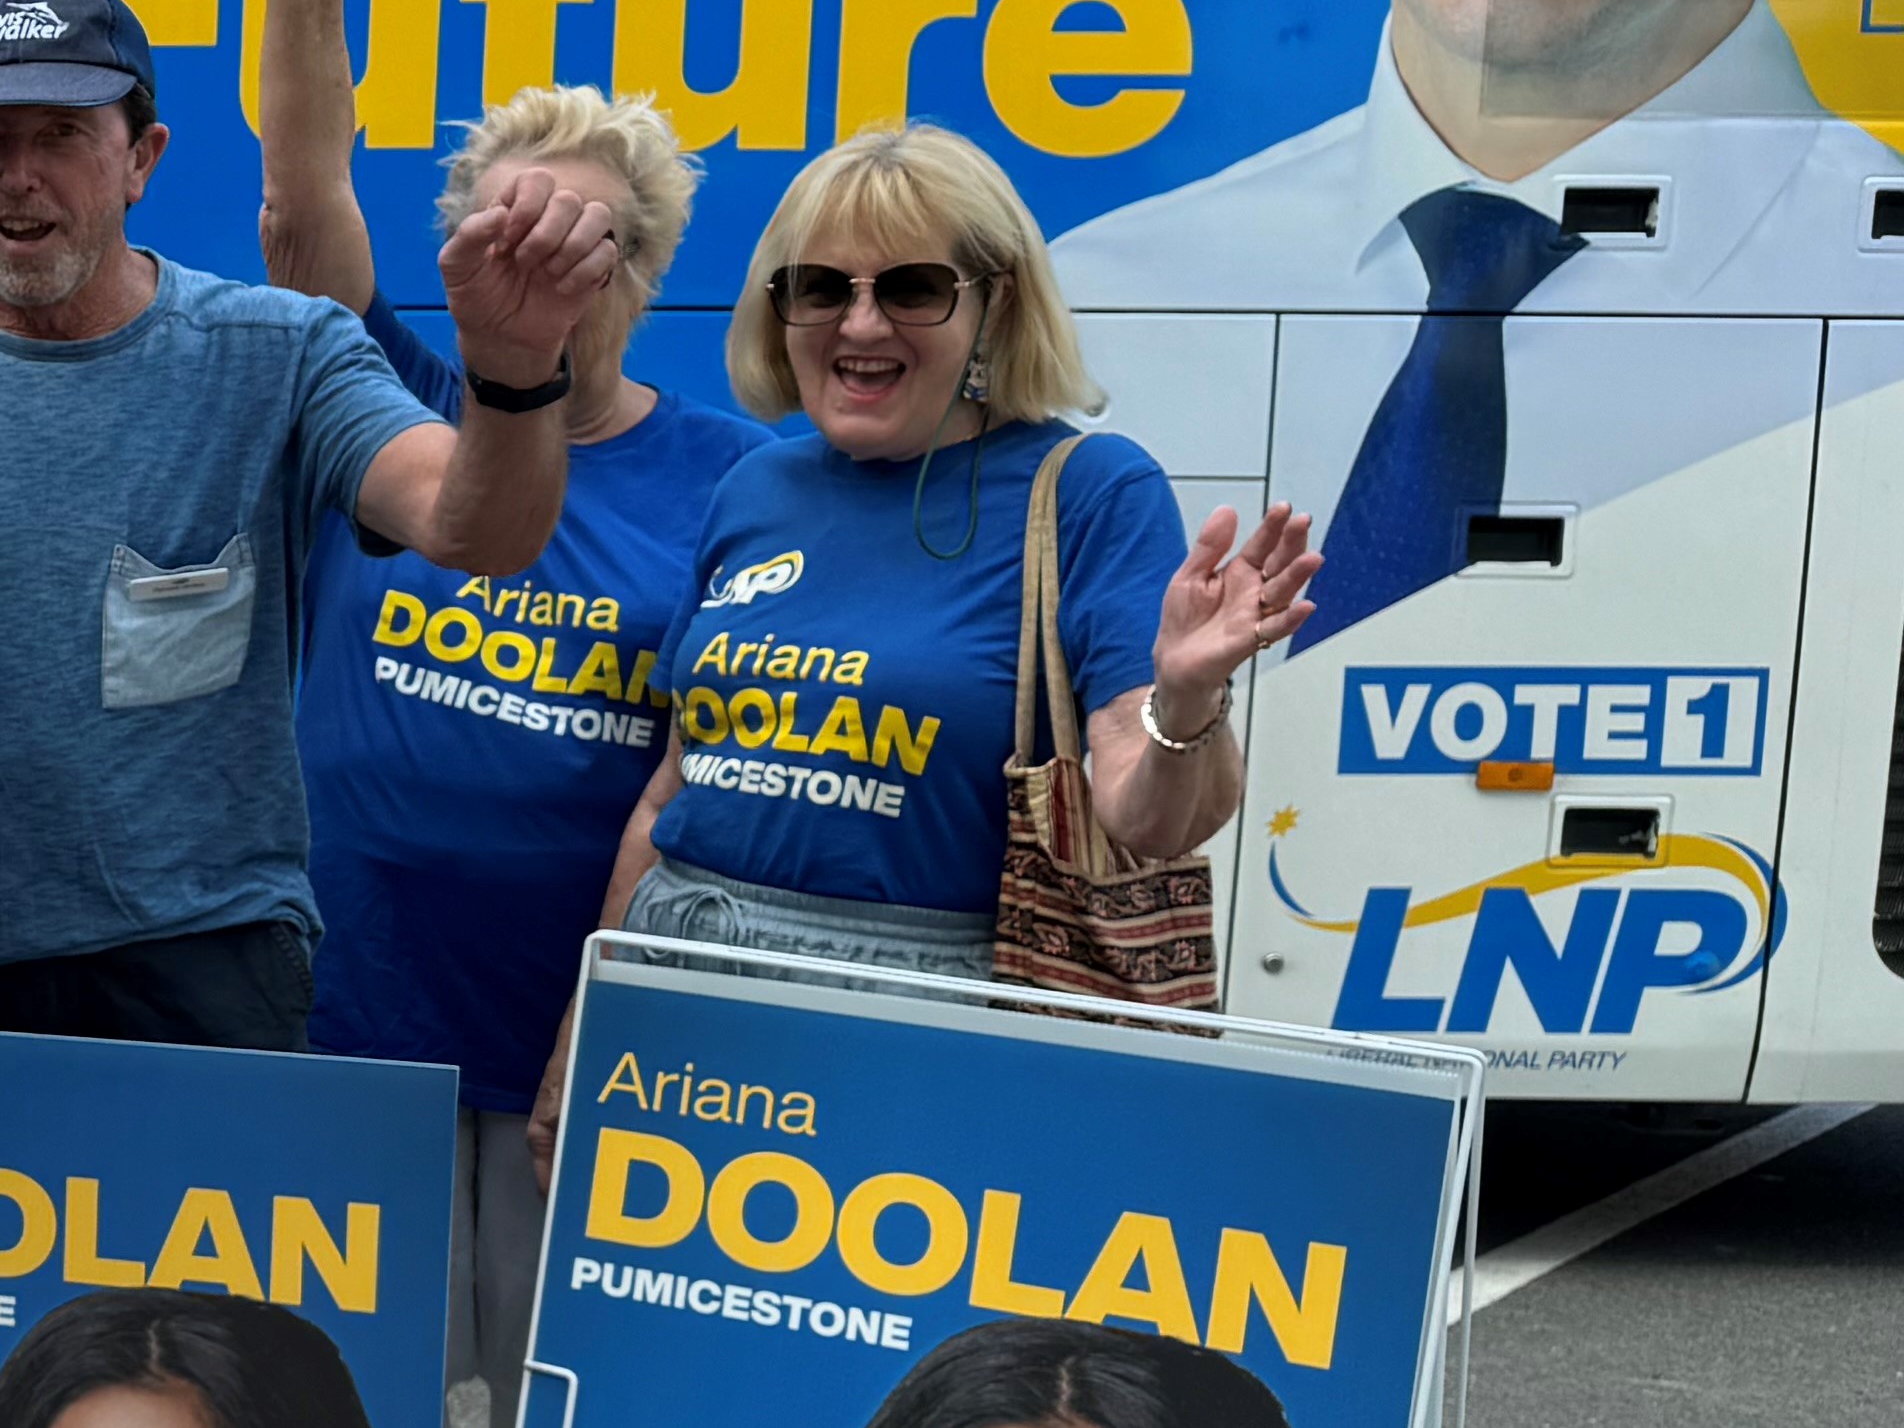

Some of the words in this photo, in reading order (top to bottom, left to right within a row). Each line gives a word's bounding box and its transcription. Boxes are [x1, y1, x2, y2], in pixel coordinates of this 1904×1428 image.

[372, 588, 672, 709] DOOLAN
[454, 575, 620, 633] Ariana
[374, 655, 656, 749] PUMICESTONE
[692, 631, 871, 686] Ariana
[672, 686, 942, 777] OOLAN
[1359, 681, 1653, 762] VOTE
[681, 752, 906, 819] MICESTONE
[1330, 886, 1748, 1035] LNP
[595, 1050, 820, 1138] Ariana
[1547, 1050, 1627, 1071] PARTY
[584, 1126, 1348, 1371] DOOLAN
[570, 1255, 914, 1352] PUMICESTONE
